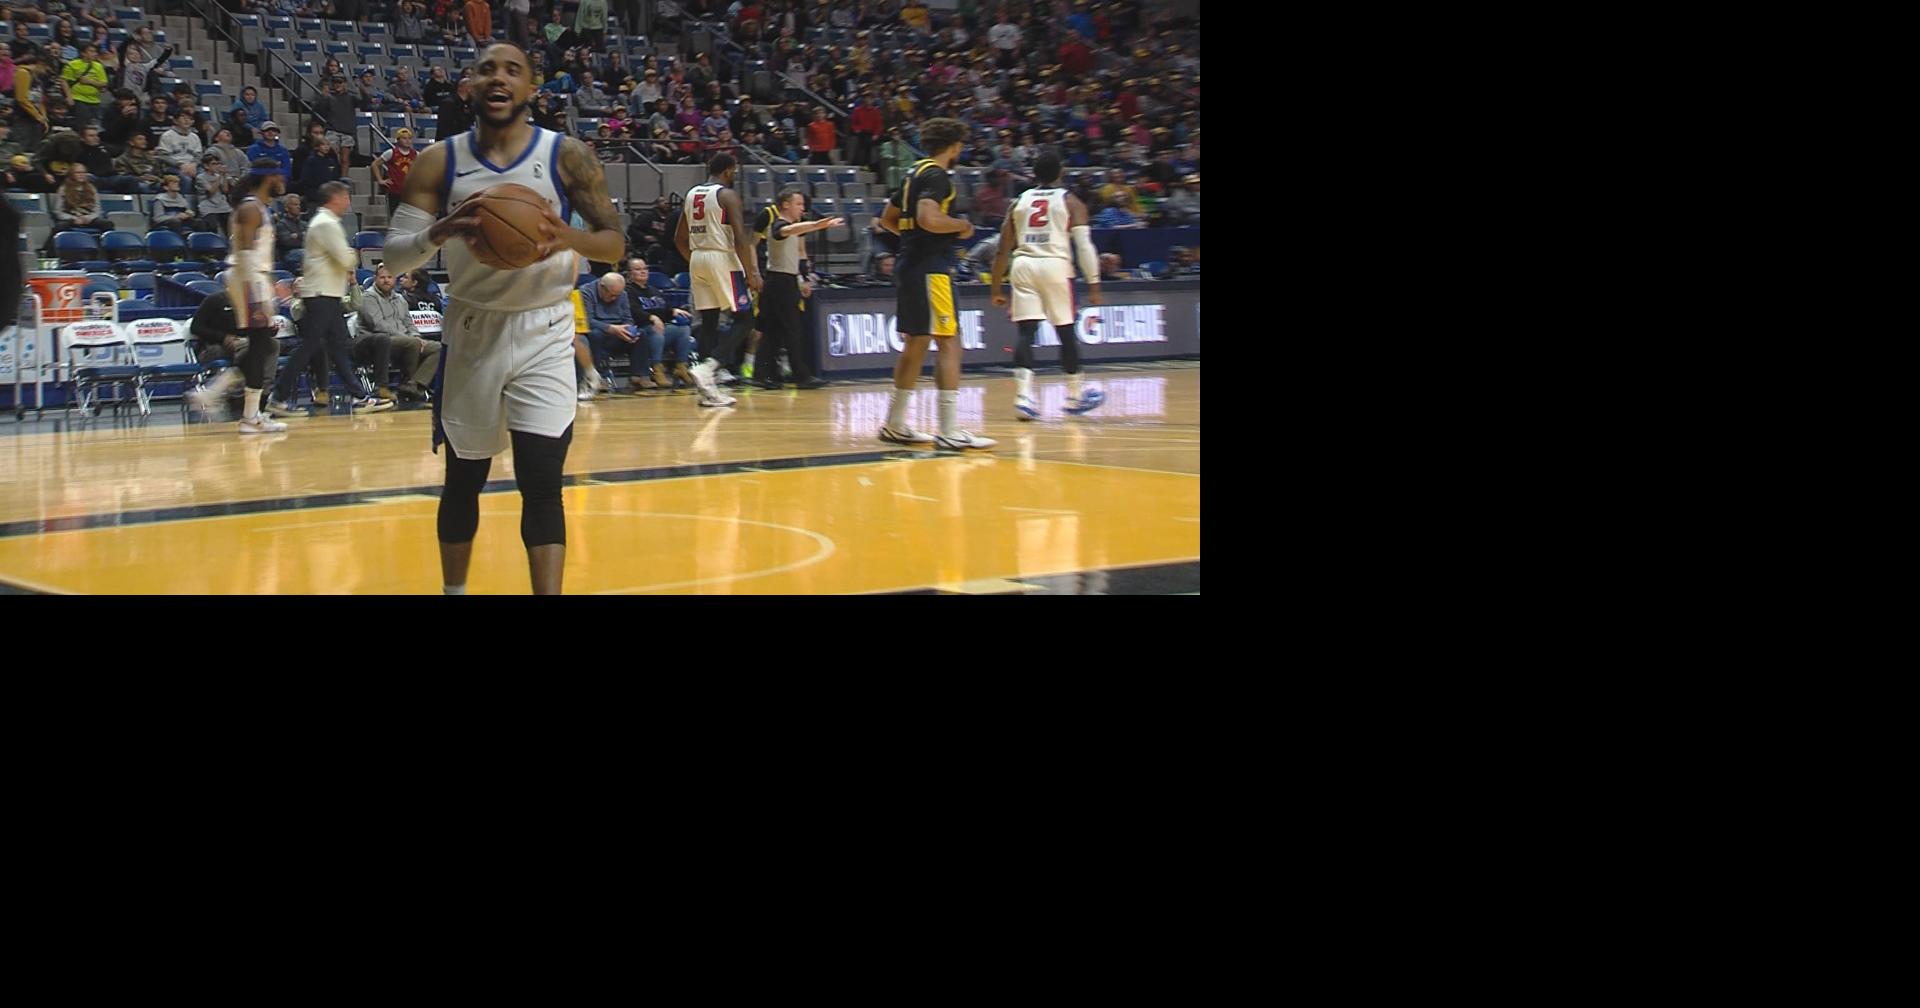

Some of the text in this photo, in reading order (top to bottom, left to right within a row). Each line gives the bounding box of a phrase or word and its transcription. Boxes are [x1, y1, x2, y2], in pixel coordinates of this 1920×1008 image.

[693, 193, 706, 221] 5
[1028, 199, 1049, 228] 2
[847, 313, 890, 354] NBA
[1074, 306, 1105, 345] G
